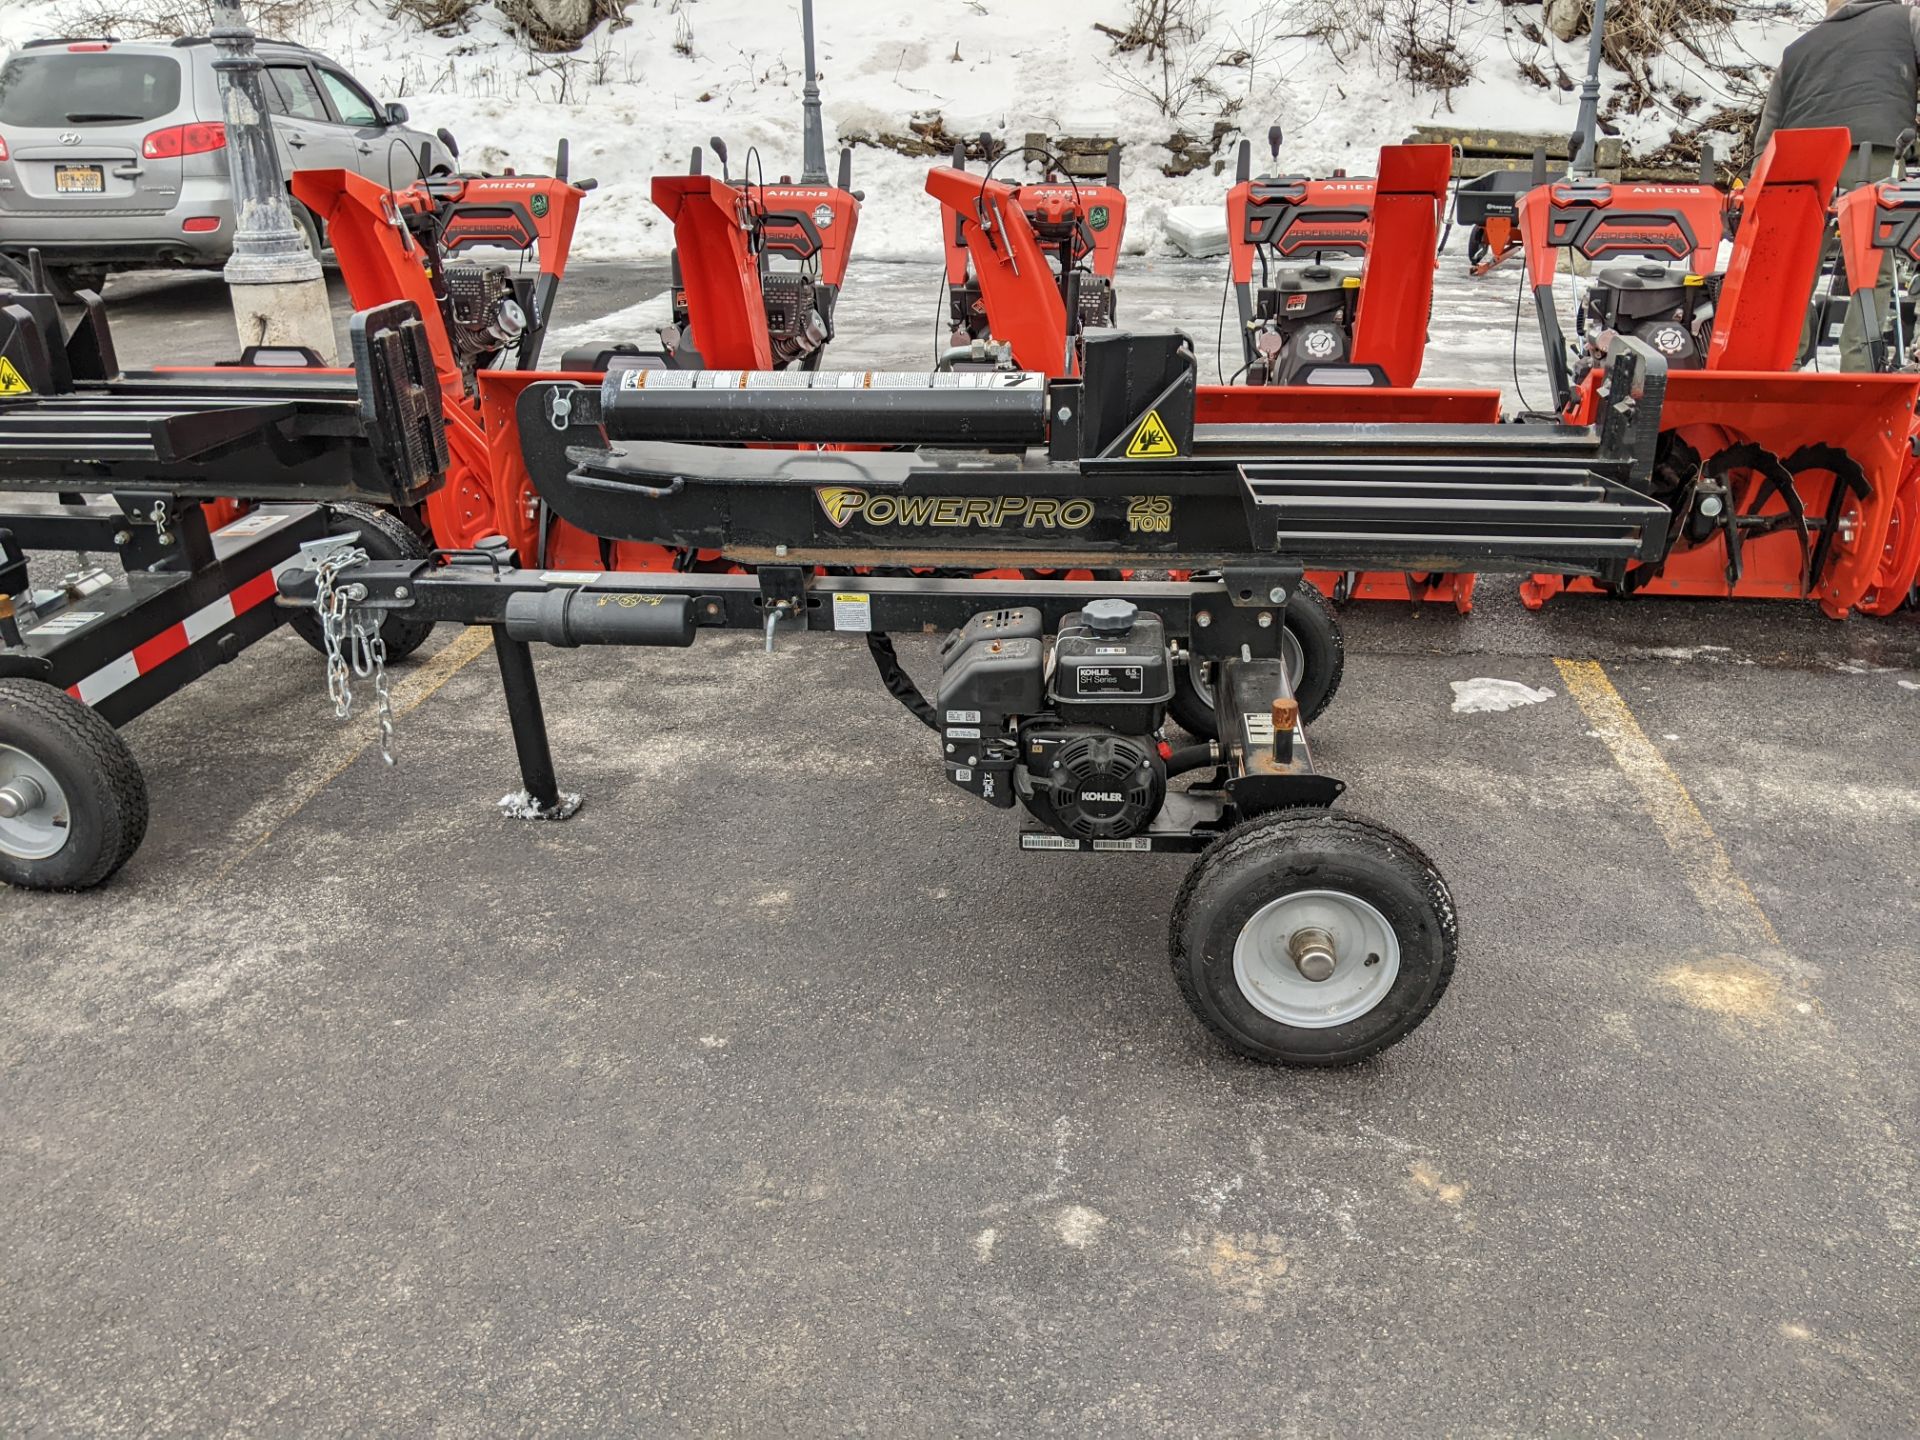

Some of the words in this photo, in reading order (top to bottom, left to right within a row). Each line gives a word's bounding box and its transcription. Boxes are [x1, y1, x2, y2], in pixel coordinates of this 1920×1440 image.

[1594, 232, 1683, 240] PROFESSIONAL
[1127, 495, 1172, 515] 25
[1127, 515, 1171, 532] TON
[1080, 675, 1093, 684] SH
[1093, 675, 1118, 684] Series
